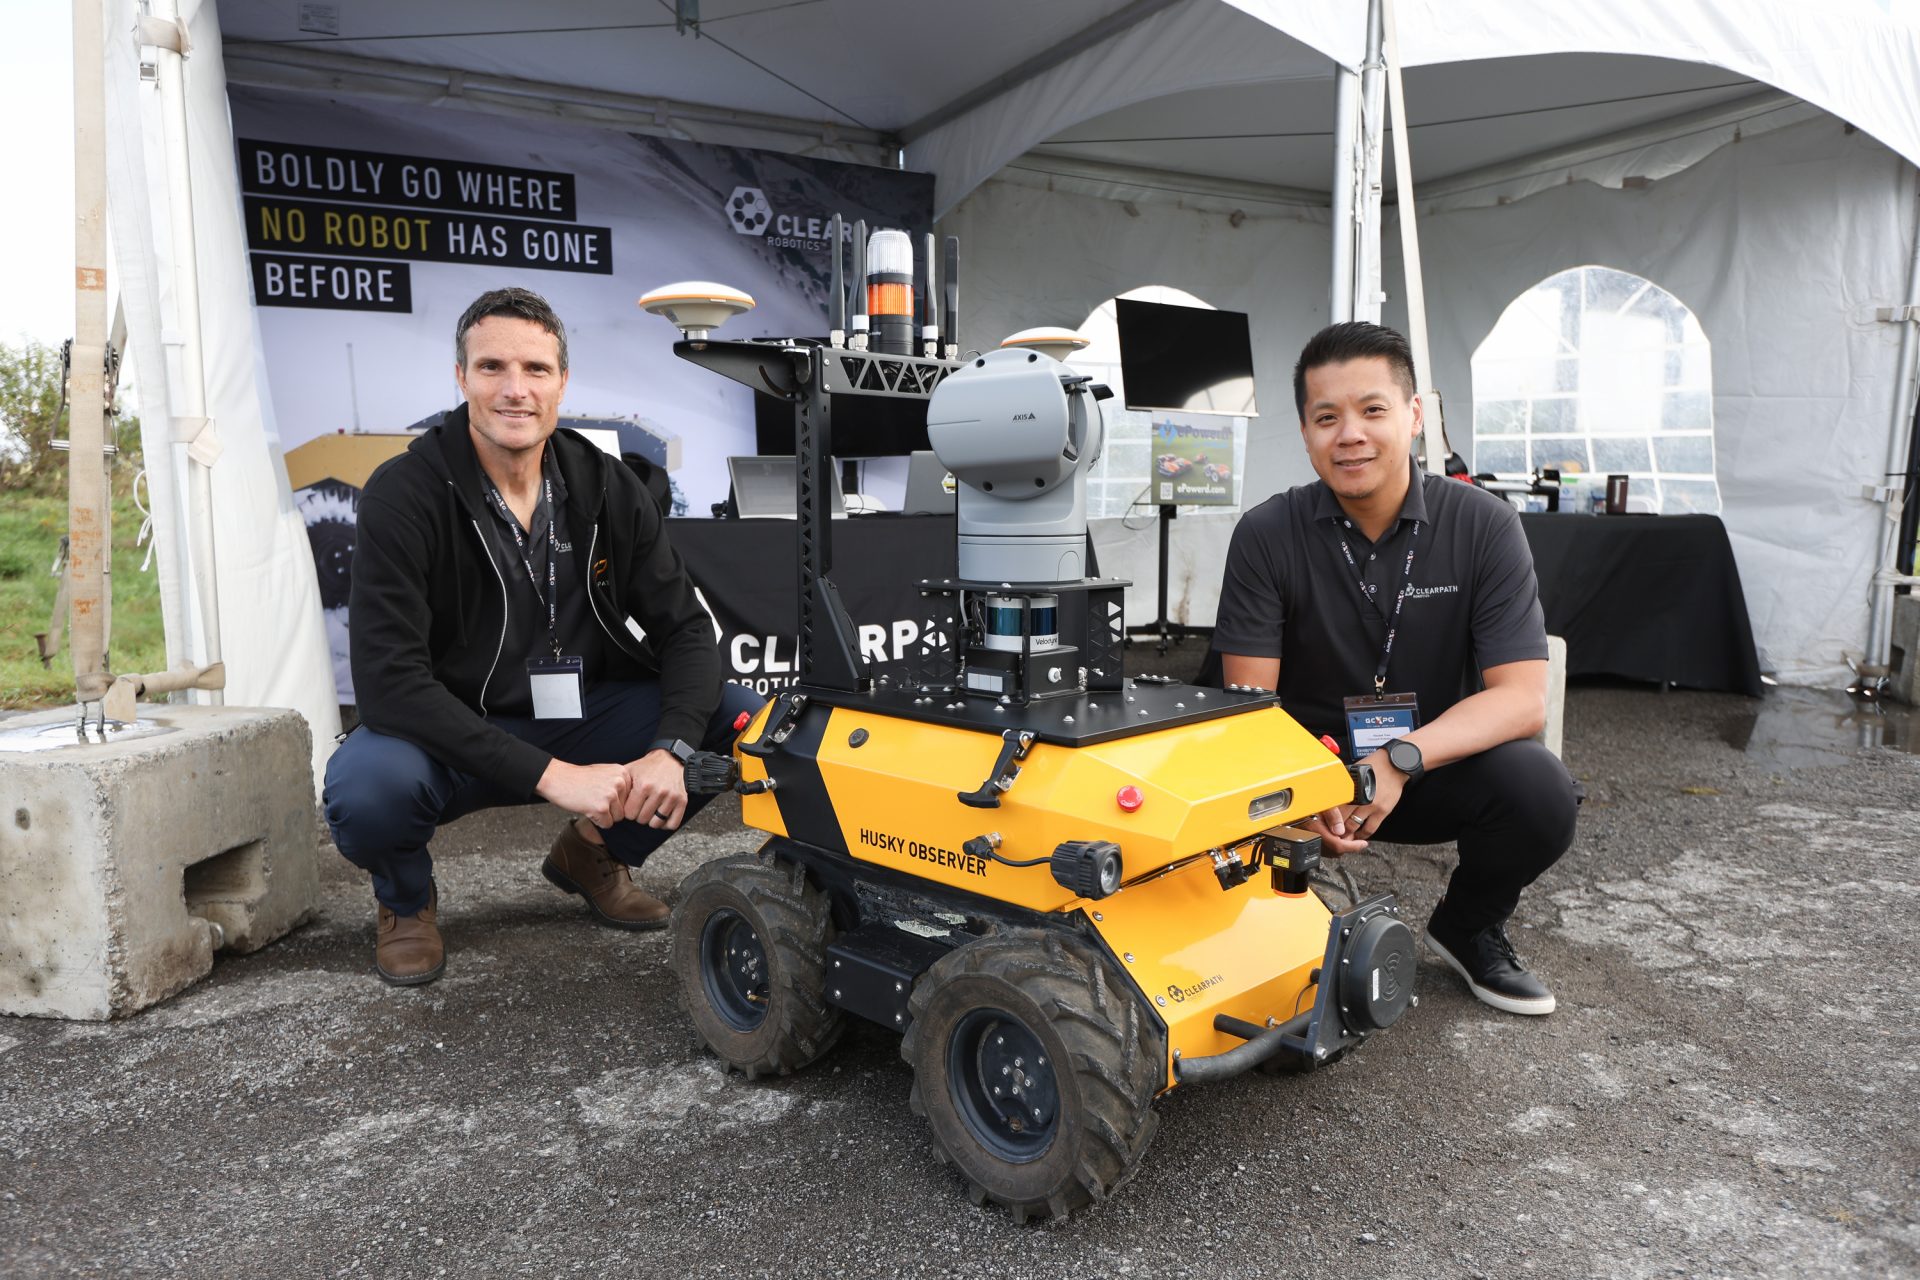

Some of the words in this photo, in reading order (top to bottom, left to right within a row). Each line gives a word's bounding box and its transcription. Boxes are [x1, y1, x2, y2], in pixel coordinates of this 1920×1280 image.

[256, 150, 384, 195] BOLDLY
[402, 165, 442, 199] GO
[458, 171, 563, 212] WHERE
[261, 207, 306, 243] NO
[324, 212, 431, 252] ROBOT
[448, 222, 508, 258] HAS
[523, 229, 599, 265] GONE
[776, 214, 912, 244] CLEAR
[265, 263, 394, 302] BEFORE
[1012, 413, 1028, 421] AXIS
[1415, 585, 1458, 596] CLEARPATH
[860, 828, 905, 854] HUSKY
[1184, 974, 1225, 997] CLEARPATH
